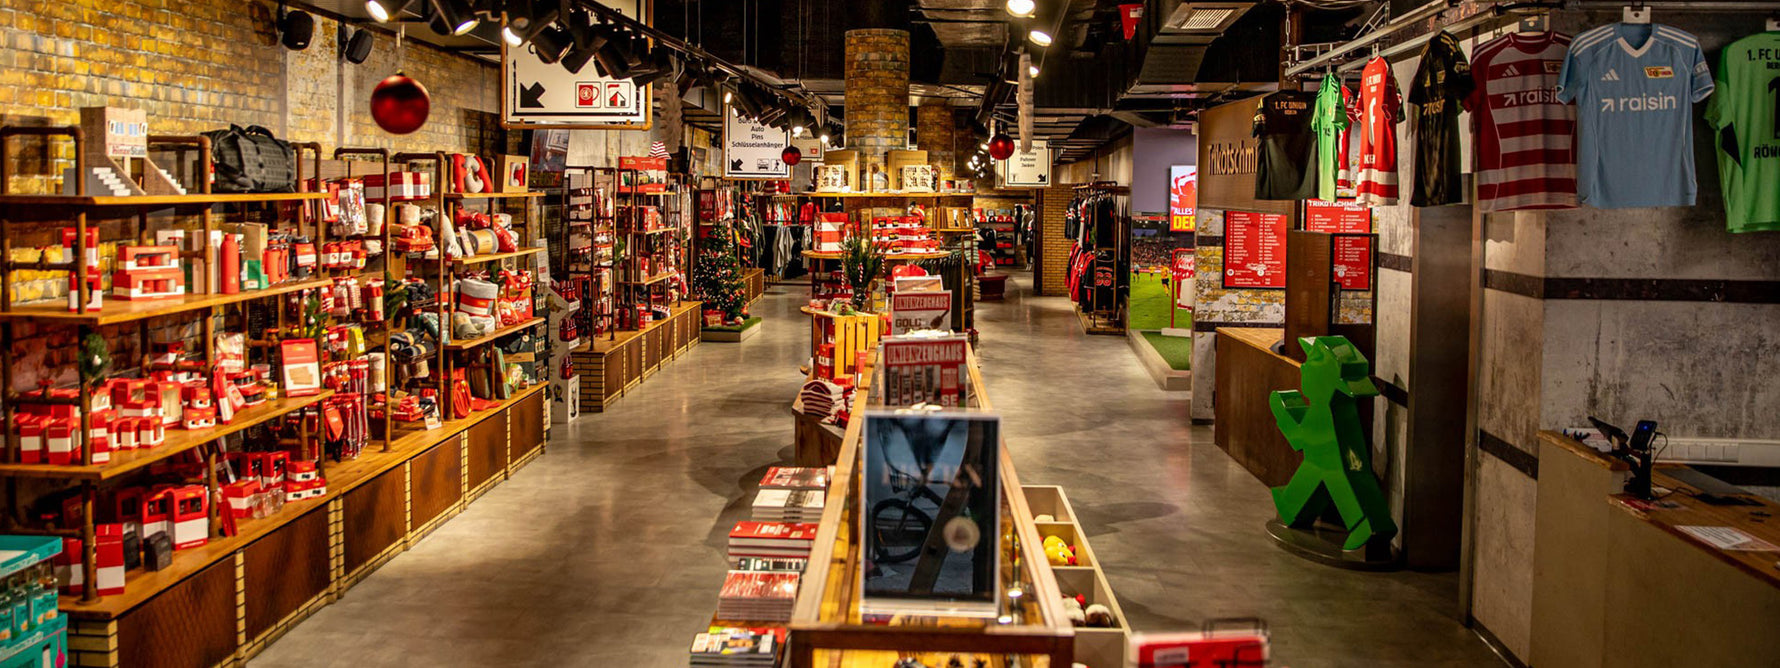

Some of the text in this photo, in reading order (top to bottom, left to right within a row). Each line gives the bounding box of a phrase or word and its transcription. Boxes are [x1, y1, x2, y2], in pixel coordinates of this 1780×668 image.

[1759, 48, 1772, 60] FC
[1520, 87, 1559, 104] raisi
[1620, 92, 1676, 111] raisin
[1207, 140, 1258, 175] Trikotschmi
[1174, 207, 1193, 215] ALLES
[888, 345, 962, 363] UNIONZEUGHAUS
